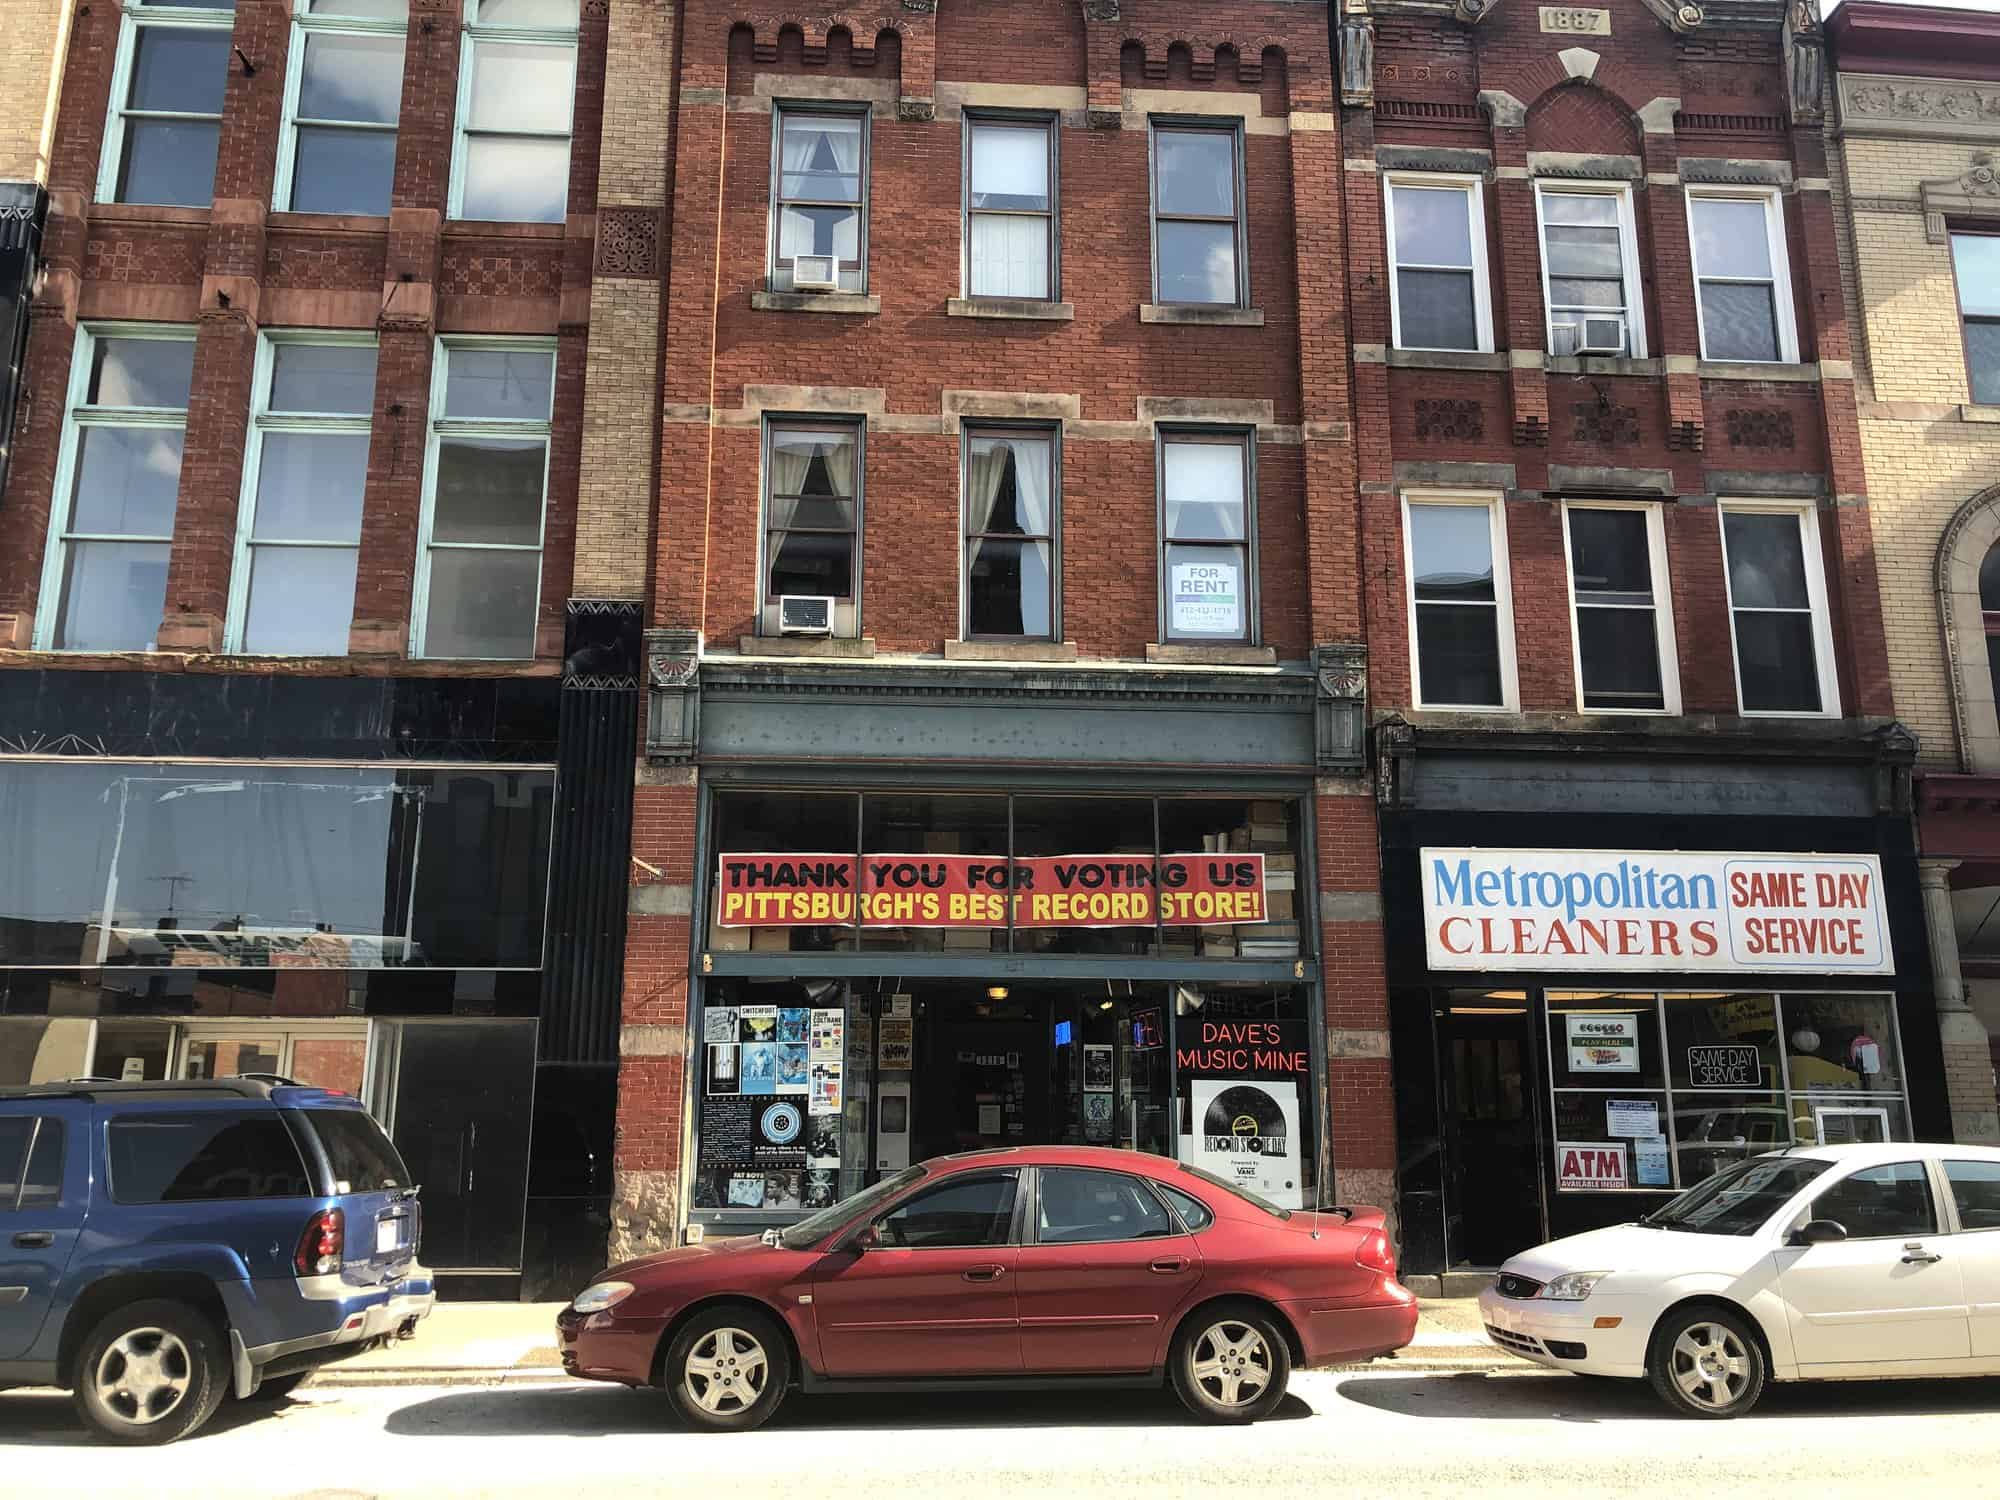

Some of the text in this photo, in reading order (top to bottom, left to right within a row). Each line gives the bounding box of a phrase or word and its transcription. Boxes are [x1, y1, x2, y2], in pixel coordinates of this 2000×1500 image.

[1546, 9, 1601, 31] 1887
[1190, 567, 1219, 578] FOR
[1181, 580, 1229, 592] RENT
[726, 862, 1257, 890] THANK YOU FOR VOTING US
[1433, 858, 1719, 923] Metropolitan
[1730, 871, 1870, 909] SAME DAY
[725, 891, 1260, 921] PITTSBURGH'S BEST RECORD STORE!
[1439, 916, 1719, 957] CLEANERS
[1744, 917, 1866, 955] SERVICE
[1202, 1023, 1280, 1045] DAVE'S
[1177, 1048, 1309, 1072] MUSIC MINE
[1691, 1050, 1754, 1067] SAME DAY
[1700, 1066, 1748, 1083] SERVICE
[1204, 1136, 1239, 1153] RECORD
[1236, 1167, 1256, 1176] VANS
[1562, 1150, 1622, 1178] ATM
[1561, 1180, 1625, 1188] AVAILABLE INSIDE
